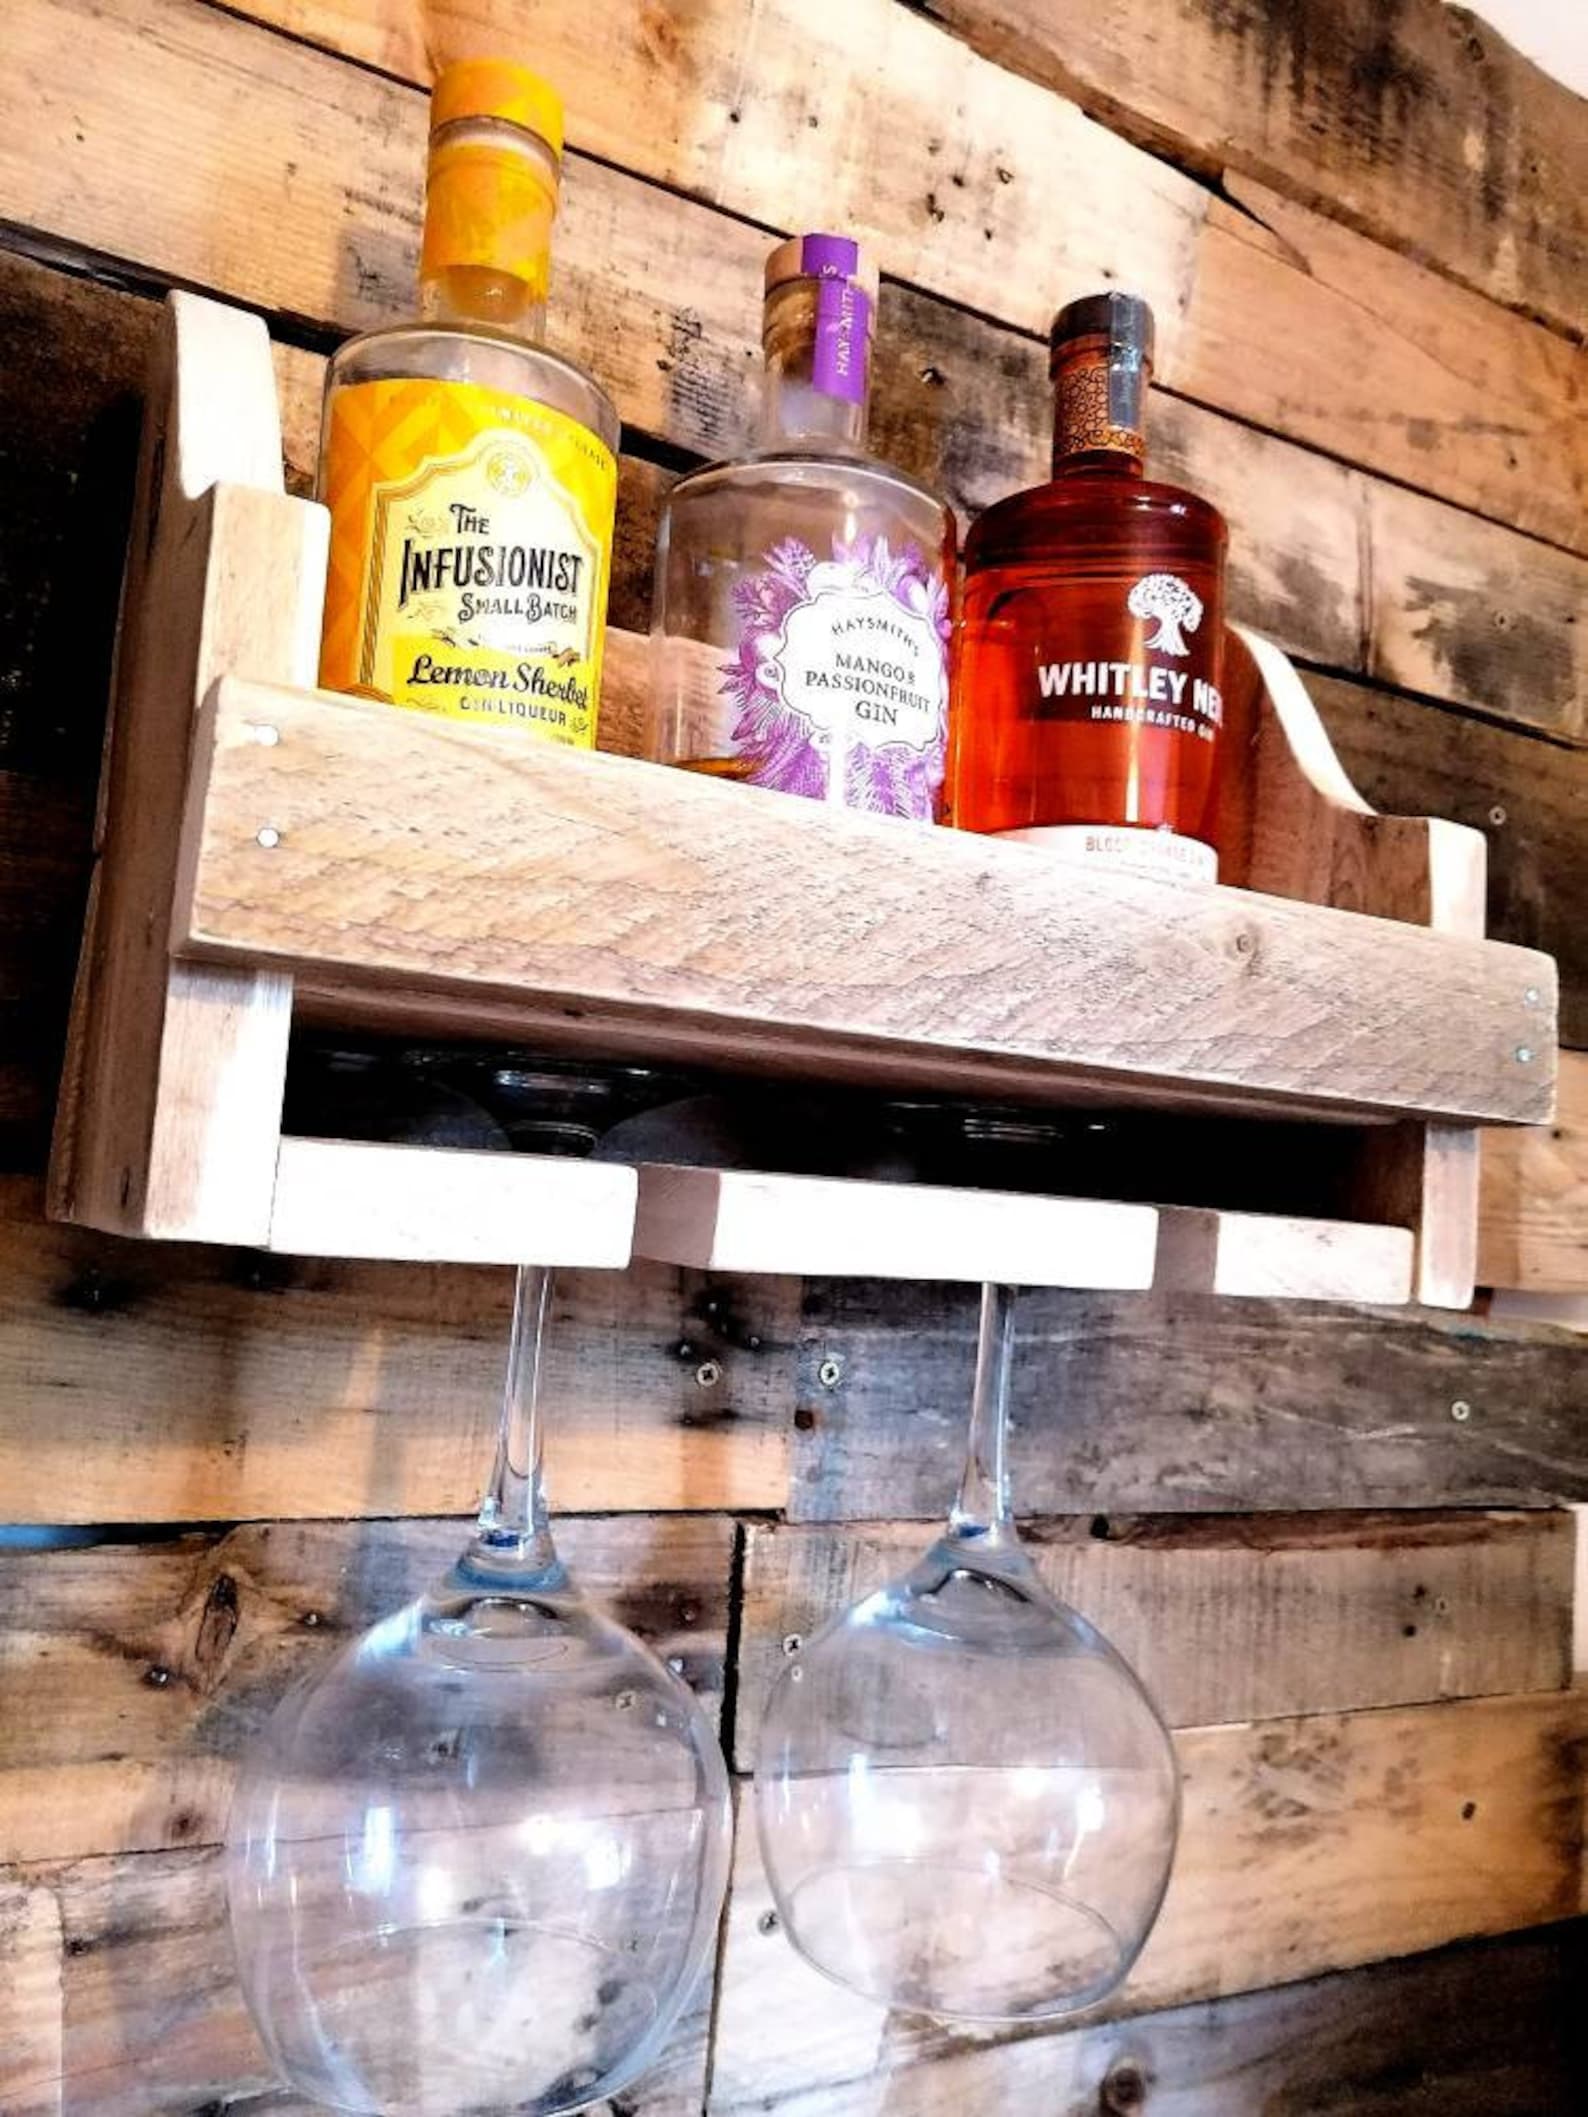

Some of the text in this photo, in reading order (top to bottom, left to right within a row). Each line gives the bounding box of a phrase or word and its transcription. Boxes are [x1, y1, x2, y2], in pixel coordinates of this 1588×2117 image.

[449, 503, 490, 535] THE
[398, 539, 582, 611] INFUSIONIST
[457, 592, 577, 623] SMALL BATCH
[406, 653, 510, 690] Lemon
[835, 653, 905, 682] MANGO
[1038, 661, 1189, 704] WHITLEY
[805, 670, 930, 713] PASSIONFRUIT
[499, 698, 567, 727] LIQUEUR
[855, 700, 898, 726] GIN
